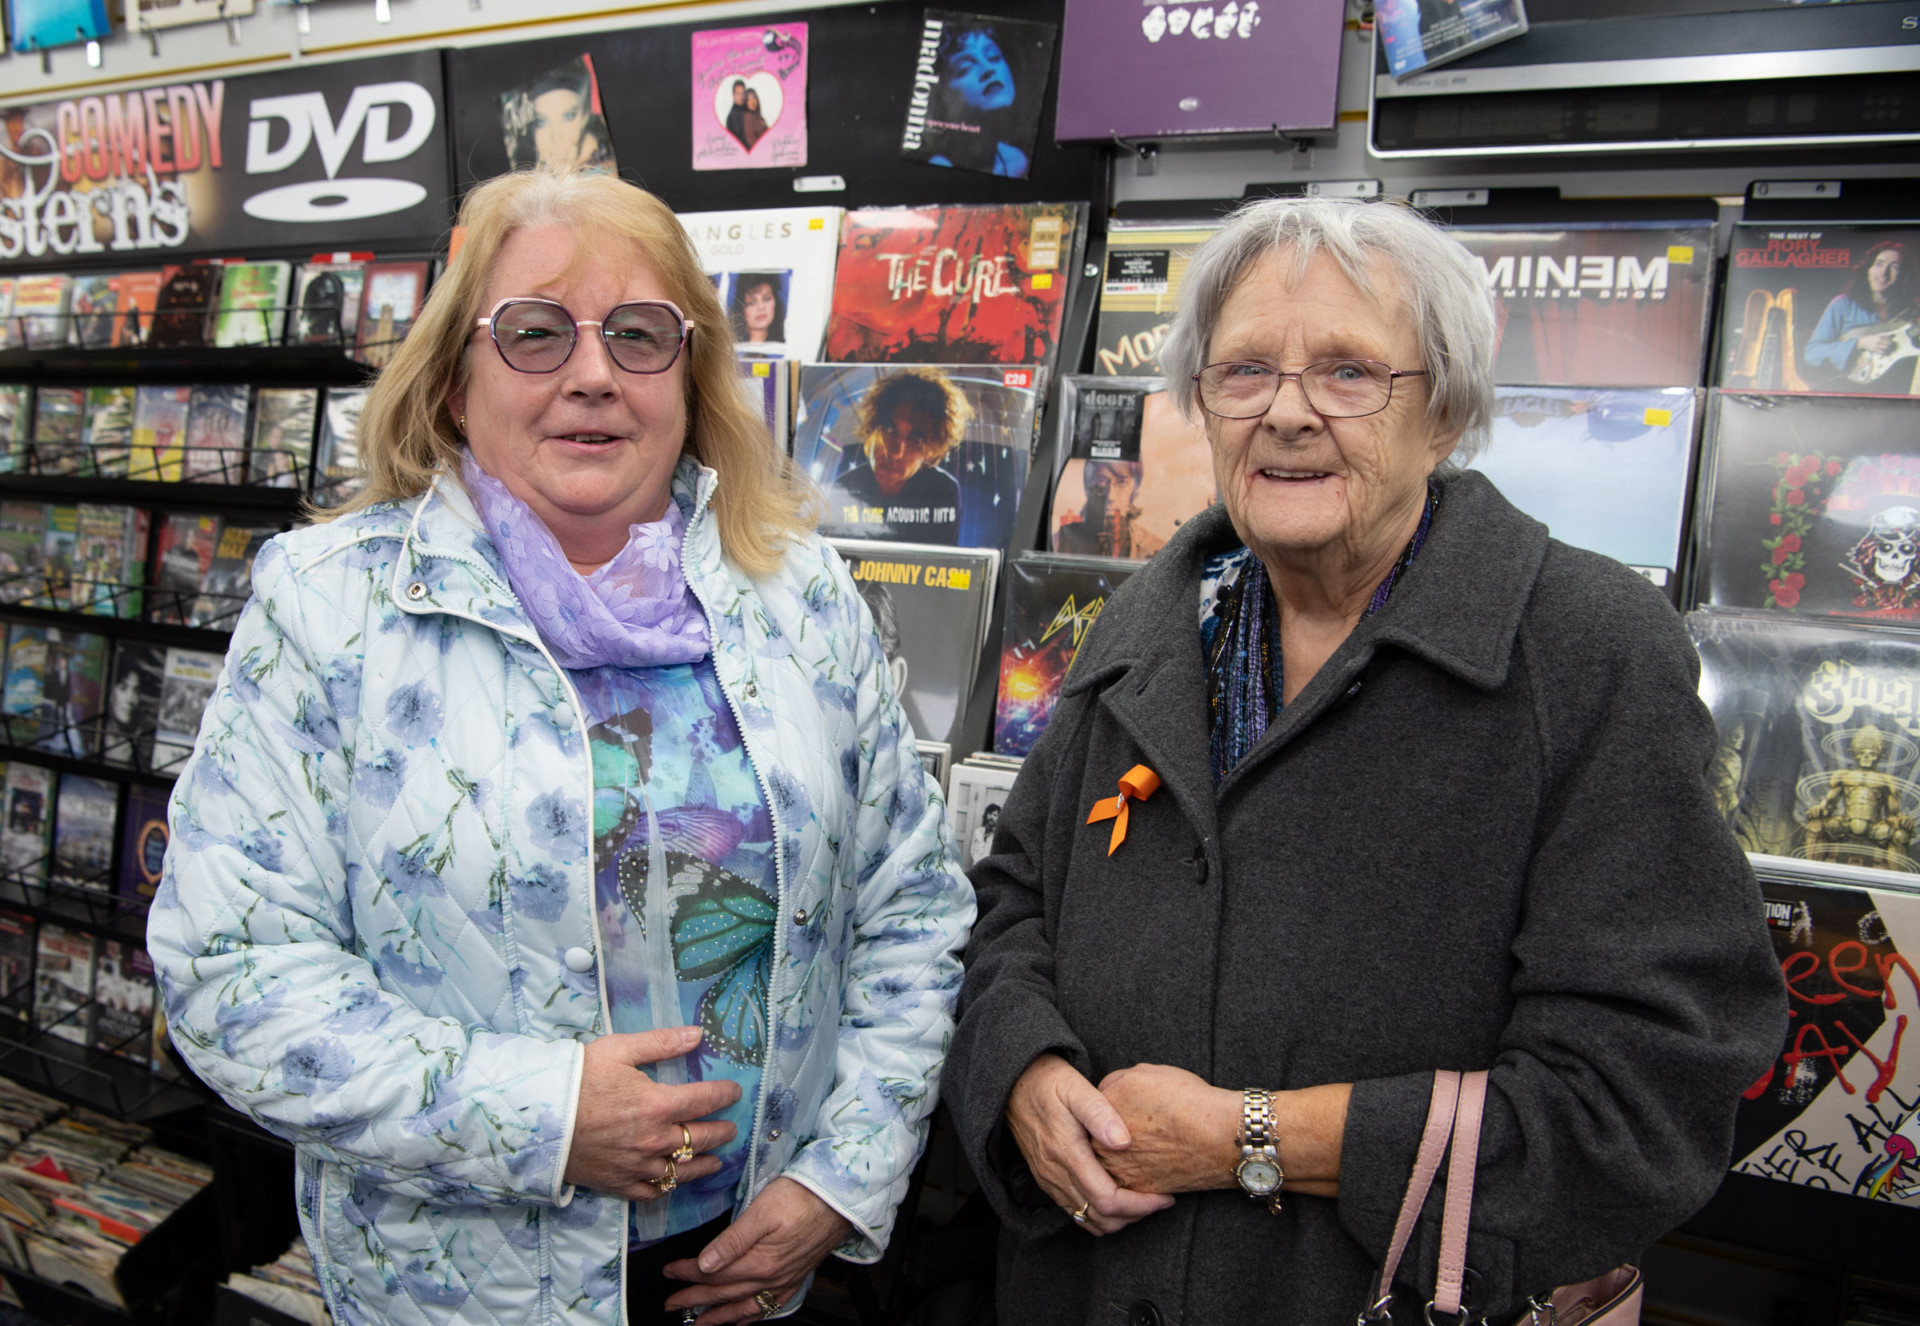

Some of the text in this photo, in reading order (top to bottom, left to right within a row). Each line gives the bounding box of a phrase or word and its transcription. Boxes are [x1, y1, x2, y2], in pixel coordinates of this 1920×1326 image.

[903, 20, 943, 150] madonna
[57, 80, 225, 183] COMEDY
[245, 81, 436, 180] DVD
[1768, 232, 1823, 240] THE BEST OF
[711, 244, 744, 257] GOLD
[1767, 240, 1821, 253] RORY
[1735, 251, 1850, 266] GALLAGHER
[875, 247, 1020, 304] THE CURE
[1599, 288, 1666, 300] SHOW
[1085, 389, 1136, 407] doors
[887, 506, 930, 523] ACOUSTIC
[933, 506, 956, 523] HITS
[853, 560, 922, 585] JOHNNY
